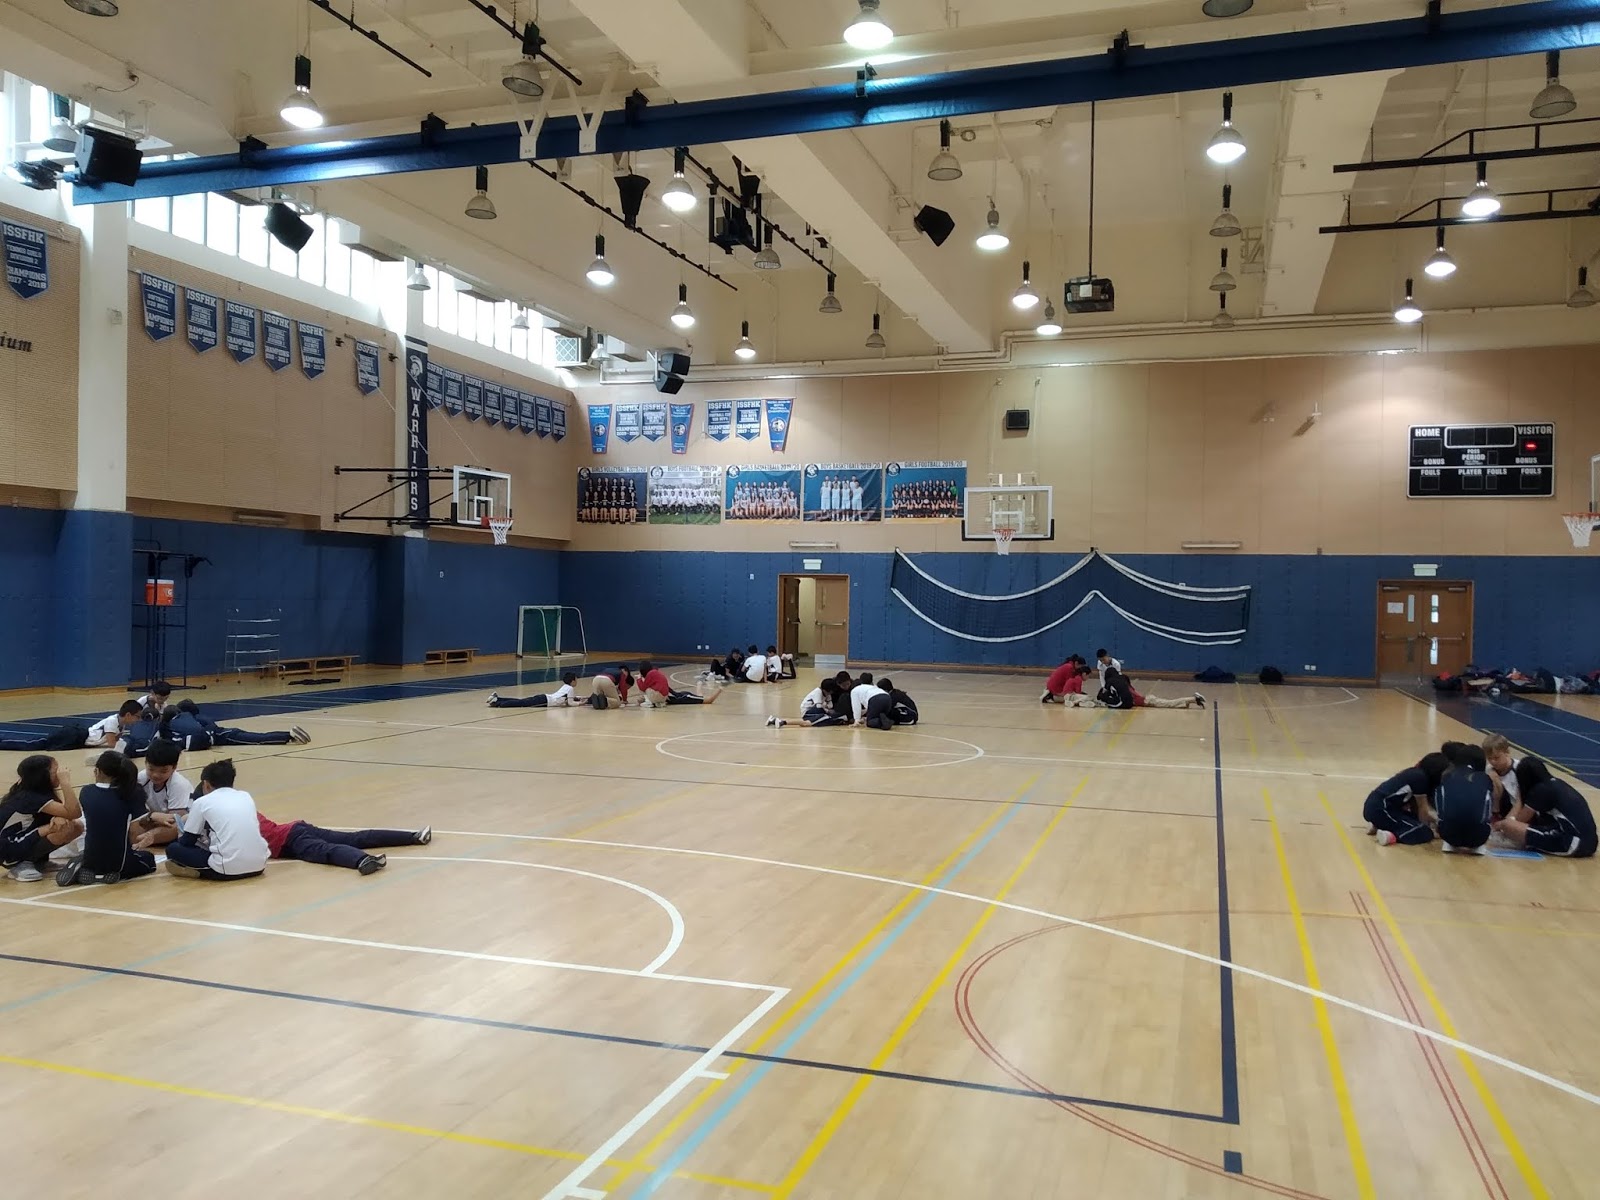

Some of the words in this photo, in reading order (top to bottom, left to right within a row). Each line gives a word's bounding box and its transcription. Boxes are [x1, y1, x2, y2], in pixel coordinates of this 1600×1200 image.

[3, 223, 44, 244] ISSFHK
[142, 274, 175, 294] ISSFHK
[187, 289, 216, 307] ISSFHK
[227, 302, 255, 318] ISSFHK
[264, 313, 290, 329] ISSFHK
[299, 323, 324, 337] ISSFHK
[616, 404, 639, 412] ISSFHK
[708, 402, 732, 410] ISSFHK
[737, 400, 761, 408] ISSFHK
[1415, 428, 1441, 437] HOME
[1517, 425, 1552, 435] VISITOR
[410, 386, 421, 511] WARRIORS
[1462, 453, 1486, 461] PERIOD
